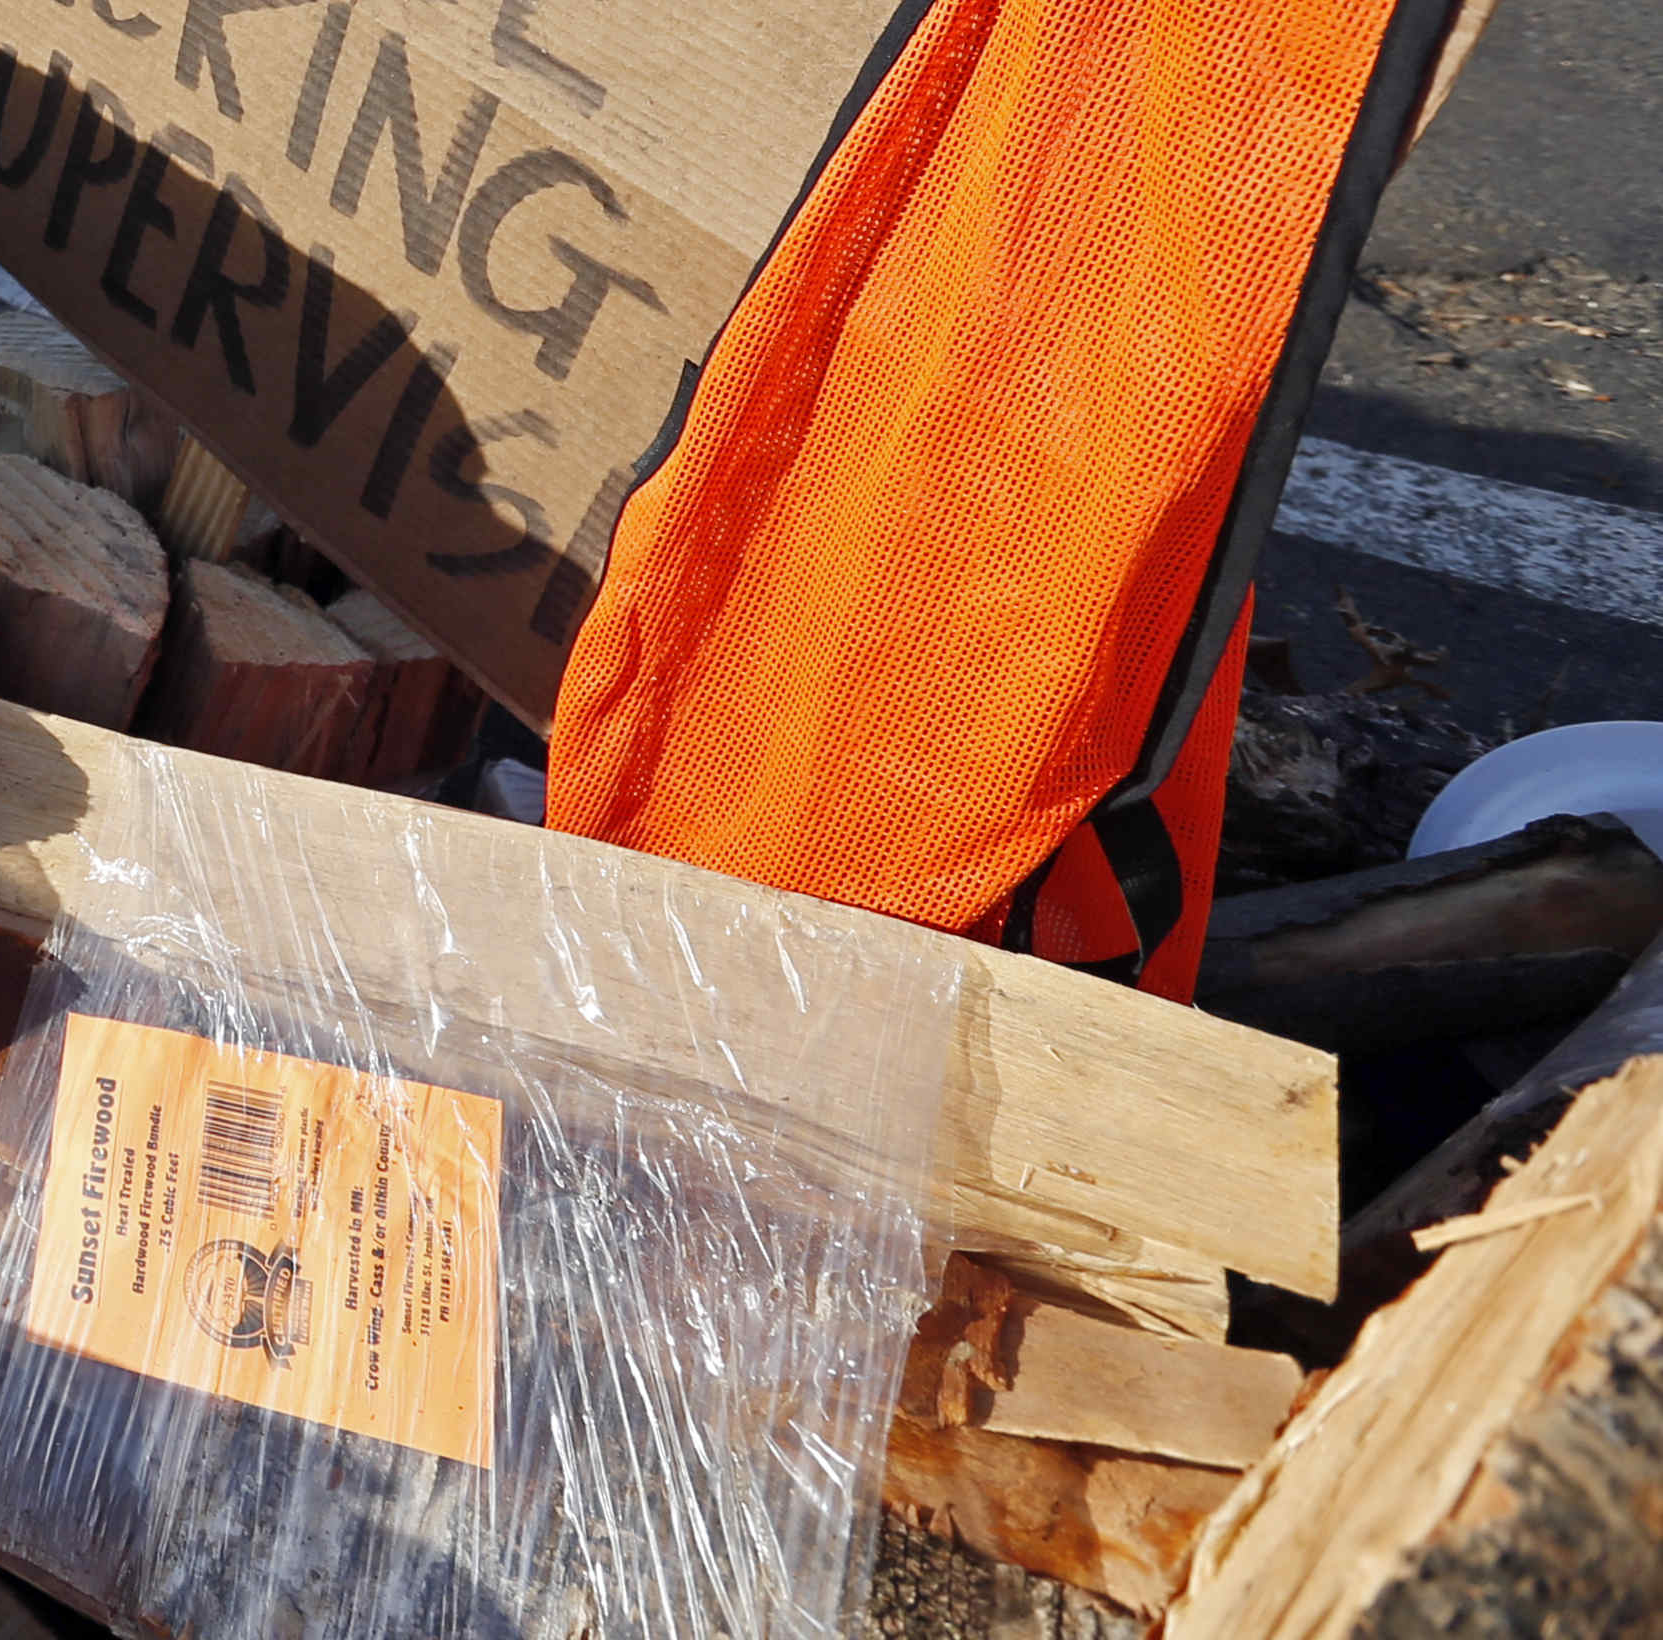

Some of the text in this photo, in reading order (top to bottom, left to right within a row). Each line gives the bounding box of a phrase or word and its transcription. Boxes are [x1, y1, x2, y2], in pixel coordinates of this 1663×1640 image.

[376, 1123, 390, 1172] County
[166, 1152, 179, 1183] Feet
[70, 1077, 116, 1304] Sunset Firewood
[116, 1148, 135, 1236] Heat Treated
[132, 1104, 162, 1294] Hardwood Firewood Bundle
[161, 1187, 177, 1225] Cubic
[373, 1177, 388, 1220] Aitkin
[344, 1186, 364, 1311] Harvested in MN:
[371, 1224, 386, 1260] &/or
[370, 1264, 384, 1298] Cass
[422, 1280, 432, 1304] Lilac
[440, 1274, 450, 1303] (218)
[402, 1298, 413, 1334] Sunset
[420, 1308, 431, 1336] 3128
[440, 1306, 450, 1322] PH
[364, 1350, 379, 1391] Crow
